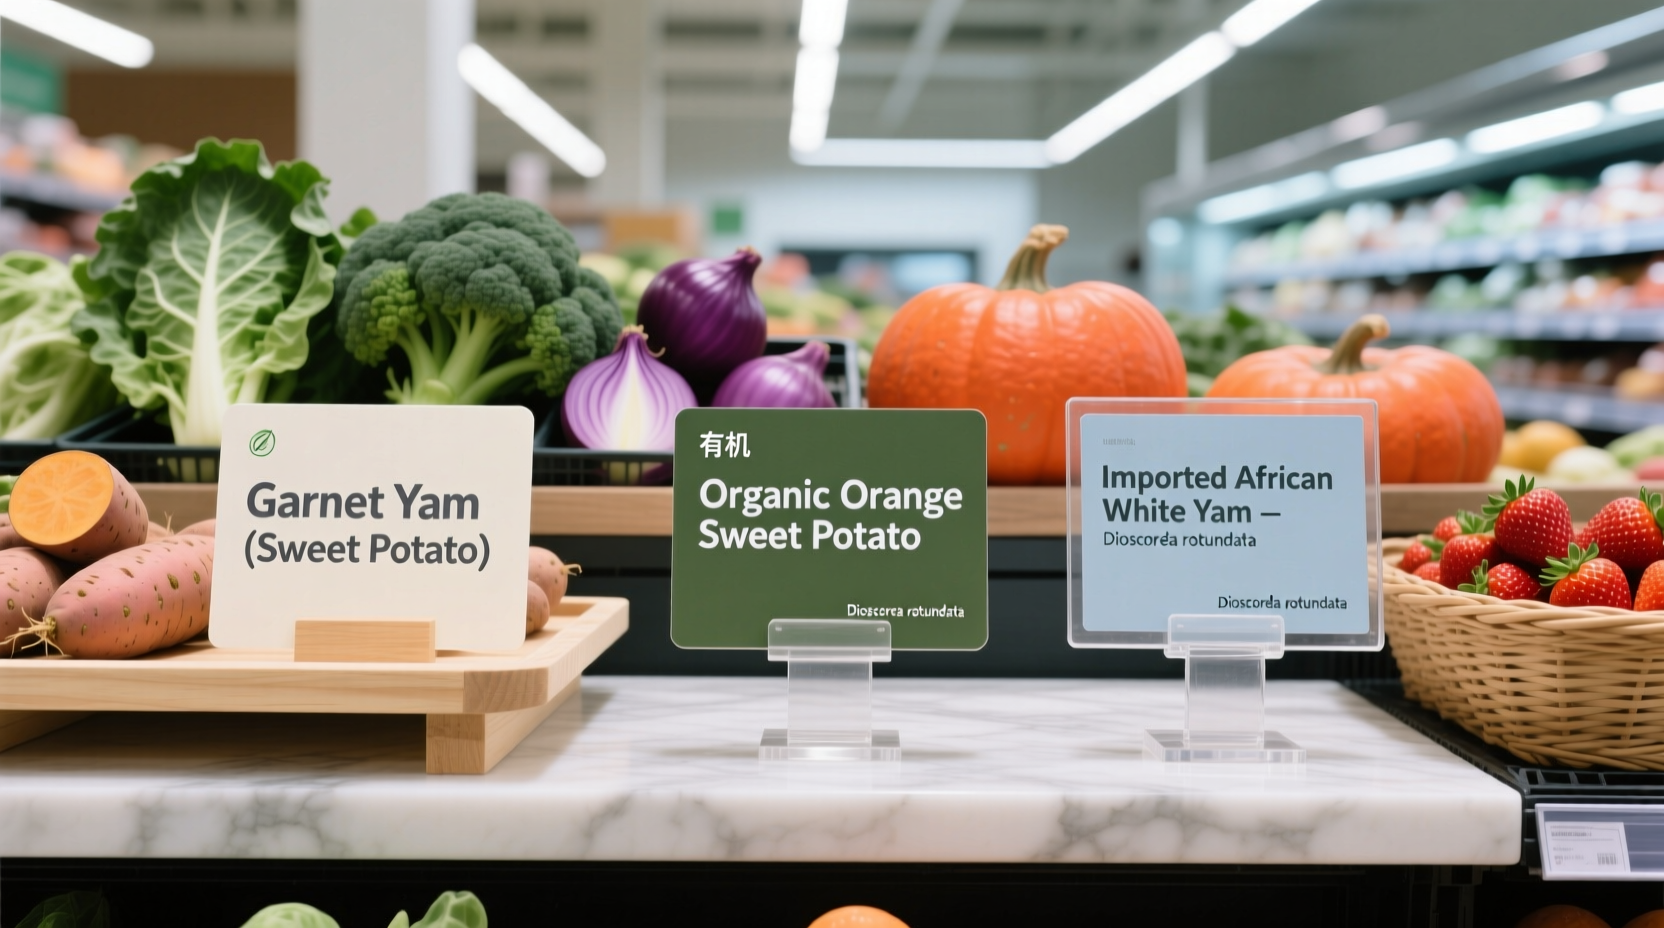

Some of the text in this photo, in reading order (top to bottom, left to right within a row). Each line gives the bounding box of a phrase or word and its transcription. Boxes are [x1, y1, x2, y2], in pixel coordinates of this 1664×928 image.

[699, 430, 751, 458] 有机
[1102, 465, 1333, 495] Imported African
[246, 482, 480, 521] Garnet Yam
[699, 478, 963, 520] Organic Orange
[1102, 498, 1186, 523] White
[1193, 499, 1252, 523] Yam
[698, 518, 922, 551] Sweet Potato
[1182, 532, 1257, 547] rotundata
[244, 529, 491, 573] (Sweet Potato)
[907, 604, 965, 618] rotundata
[1285, 596, 1348, 610] rotundata
